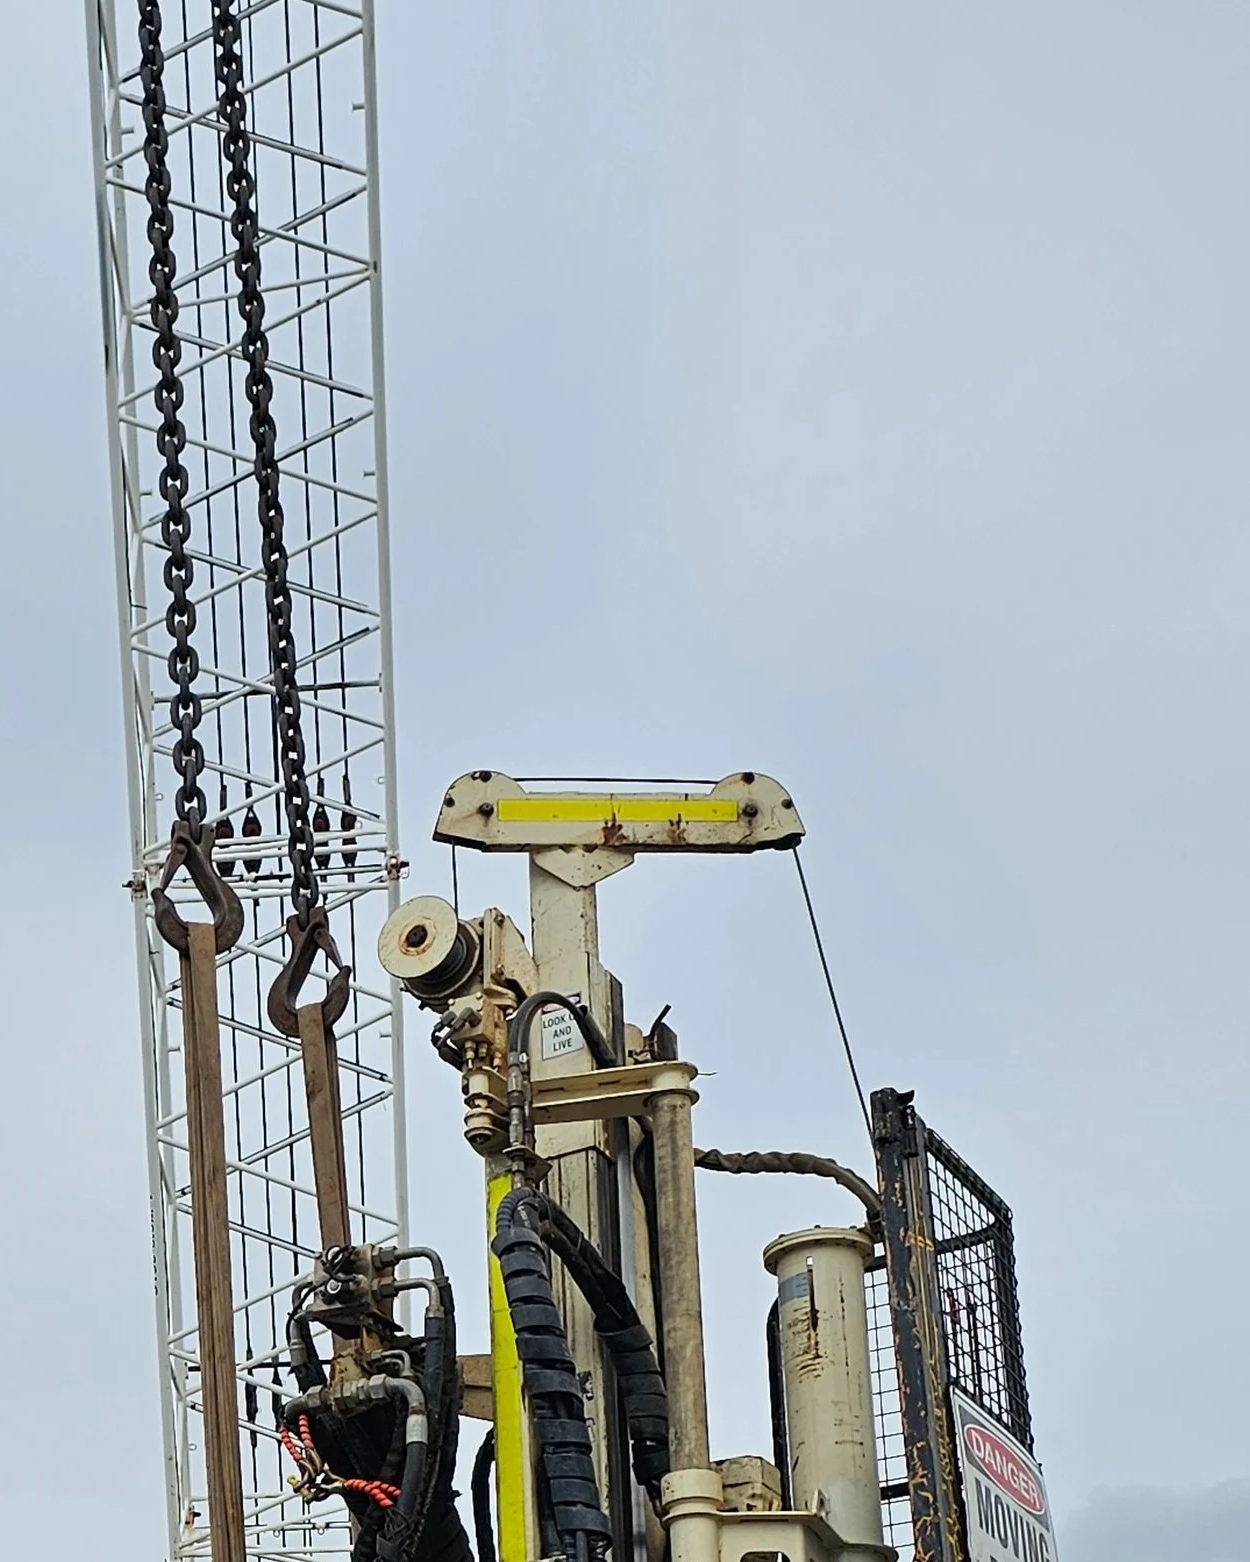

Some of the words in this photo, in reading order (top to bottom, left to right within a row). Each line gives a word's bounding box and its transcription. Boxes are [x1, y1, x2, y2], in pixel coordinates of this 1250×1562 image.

[543, 1014, 566, 1028] LOOK
[553, 1026, 571, 1039] AND
[553, 1038, 573, 1051] LIVE
[970, 1428, 1040, 1509] DANGER
